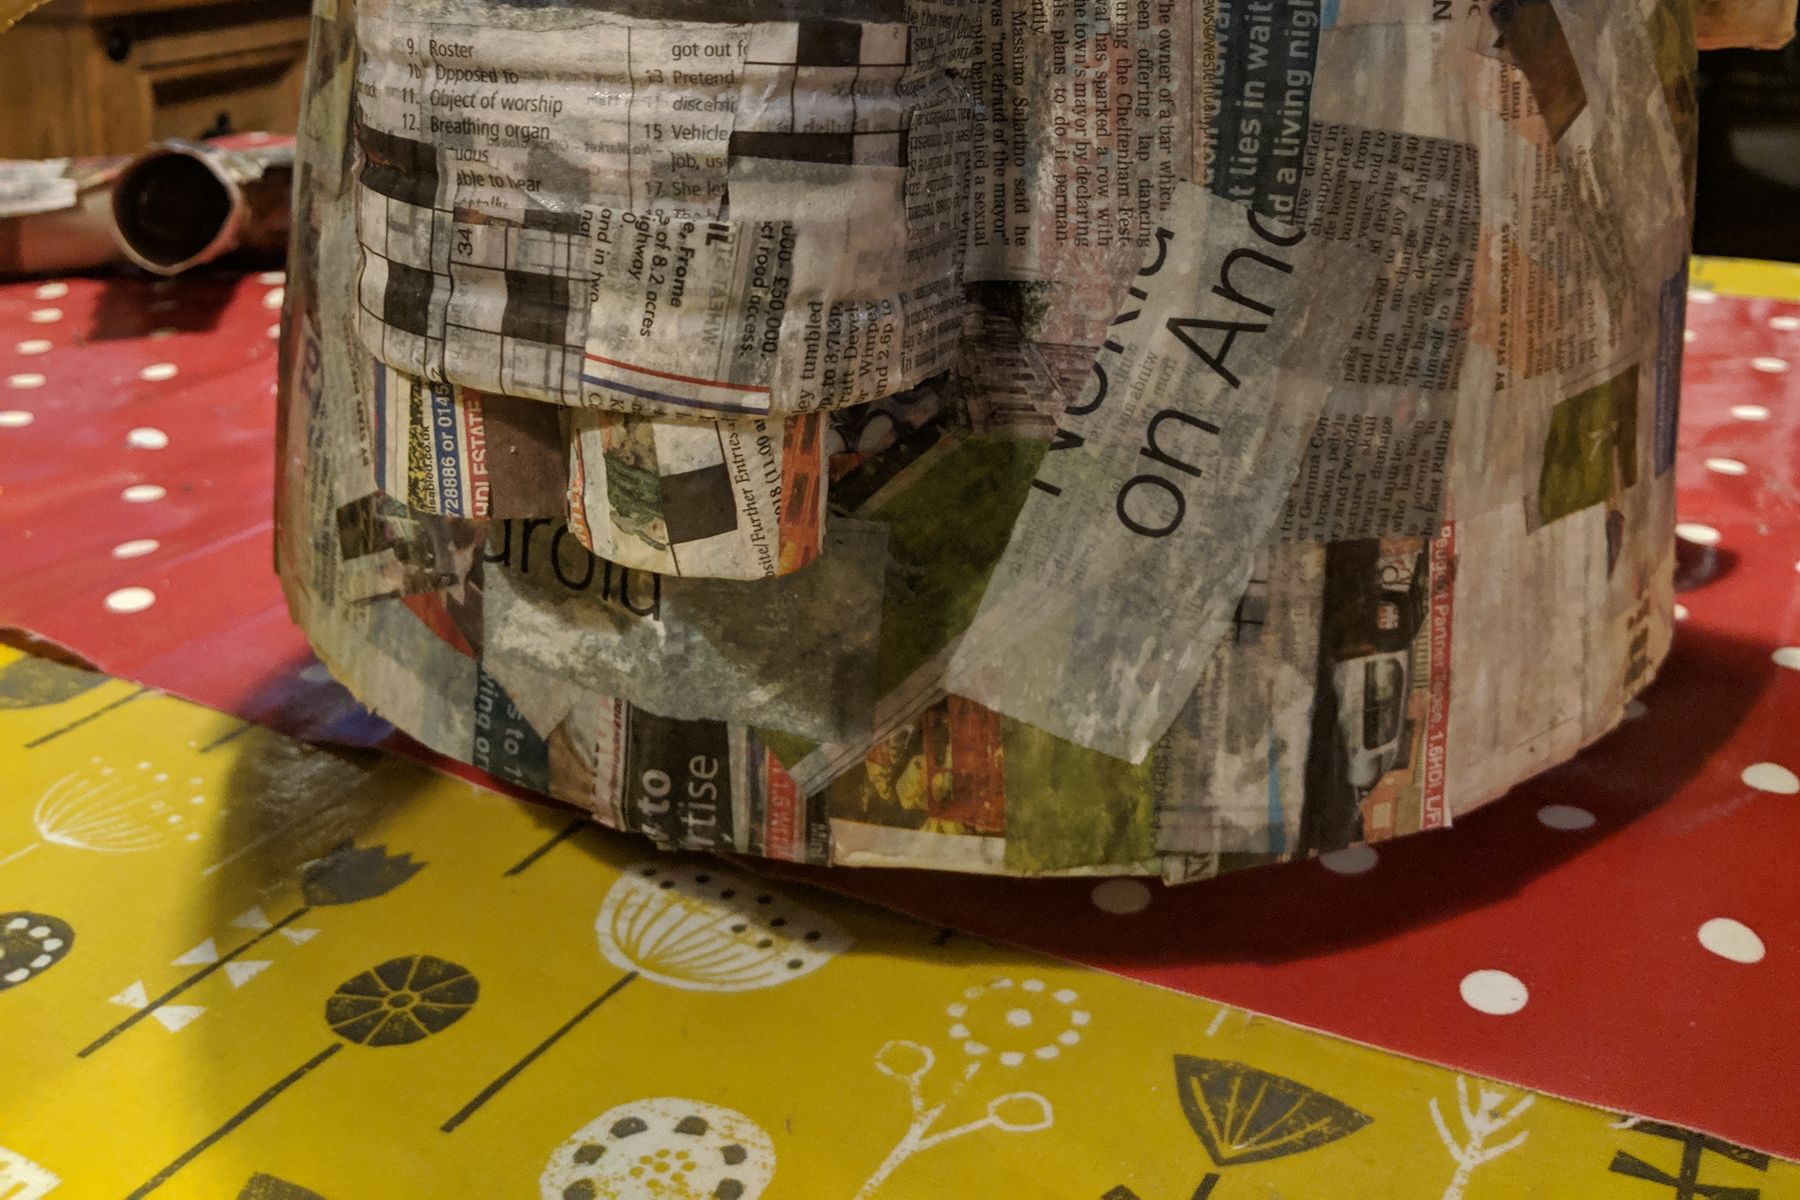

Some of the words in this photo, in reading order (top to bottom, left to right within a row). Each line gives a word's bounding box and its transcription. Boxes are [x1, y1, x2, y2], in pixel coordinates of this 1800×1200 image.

[406, 37, 418, 56] 9.
[428, 38, 474, 58] Roster
[672, 41, 701, 61] got
[704, 42, 731, 59] out
[1011, 9, 1029, 88] Massimo
[1051, 30, 1070, 76] plans
[1094, 32, 1112, 62] has
[1245, 0, 1275, 71] wait
[1115, 57, 1134, 85] the
[1158, 28, 1173, 84] owner
[503, 68, 519, 85] to
[672, 69, 736, 86] Pretend
[1135, 48, 1155, 118] offering
[1236, 80, 1267, 110] in
[429, 88, 477, 112] Object
[479, 91, 499, 111] of
[501, 94, 563, 118] worship
[991, 72, 1010, 123] afraid
[1053, 87, 1068, 105] to
[1070, 82, 1088, 138] mayor
[1093, 71, 1113, 140] sparked
[1158, 87, 1174, 108] of
[1159, 110, 1171, 120] a
[1271, 68, 1313, 157] living
[401, 113, 420, 132] 12.
[429, 115, 500, 143] Breathing
[504, 123, 551, 142] organ
[642, 122, 663, 141] 15
[671, 123, 728, 142] Vehicle
[973, 111, 991, 172] denied
[992, 124, 1010, 144] of
[1011, 96, 1030, 169] Salatino
[1053, 114, 1071, 138] do
[1115, 92, 1134, 198] Cheltenham
[1158, 120, 1176, 156] bar
[1373, 131, 1387, 148] to
[992, 145, 1010, 174] the
[1053, 147, 1069, 162] it
[1072, 142, 1091, 161] by
[1096, 146, 1109, 157] a
[1136, 135, 1155, 162] lap
[1228, 117, 1264, 176] lies
[1303, 121, 1326, 177] deficit
[1401, 136, 1421, 173] £140
[488, 172, 504, 189] to
[671, 179, 701, 198] She
[974, 175, 987, 187] a
[1096, 166, 1110, 197] row
[1277, 166, 1297, 186] a
[1315, 143, 1338, 209] support
[1339, 179, 1363, 243] banned
[1352, 129, 1372, 171] from
[1367, 153, 1384, 186] told
[1372, 170, 1399, 234] driving
[1388, 133, 1403, 165] test
[1011, 177, 1030, 216] said
[1051, 172, 1069, 247] perman-
[1072, 165, 1093, 248] declaring
[1136, 177, 1155, 249] dancing
[596, 208, 612, 244] and
[973, 193, 991, 249] sexual
[1012, 225, 1031, 247] he
[1096, 207, 1115, 247] with
[458, 227, 473, 257] 34
[593, 248, 606, 266] in
[653, 230, 672, 252] of
[648, 254, 669, 286] 8.2
[670, 246, 696, 309] Frome
[752, 245, 770, 291] road
[640, 290, 661, 338] acres
[738, 295, 762, 359] access.
[760, 275, 791, 360] £50,000.
[802, 301, 824, 381] tumbled
[858, 300, 881, 378] Wimpey
[877, 322, 895, 362] 2.6p
[822, 369, 838, 388] to
[441, 431, 455, 453] or
[730, 432, 752, 485] Entries
[1115, 408, 1222, 540] on
[1299, 453, 1322, 519] Gemma
[1313, 468, 1336, 528] broken
[1431, 603, 1452, 668] Partner
[636, 768, 673, 815] to
